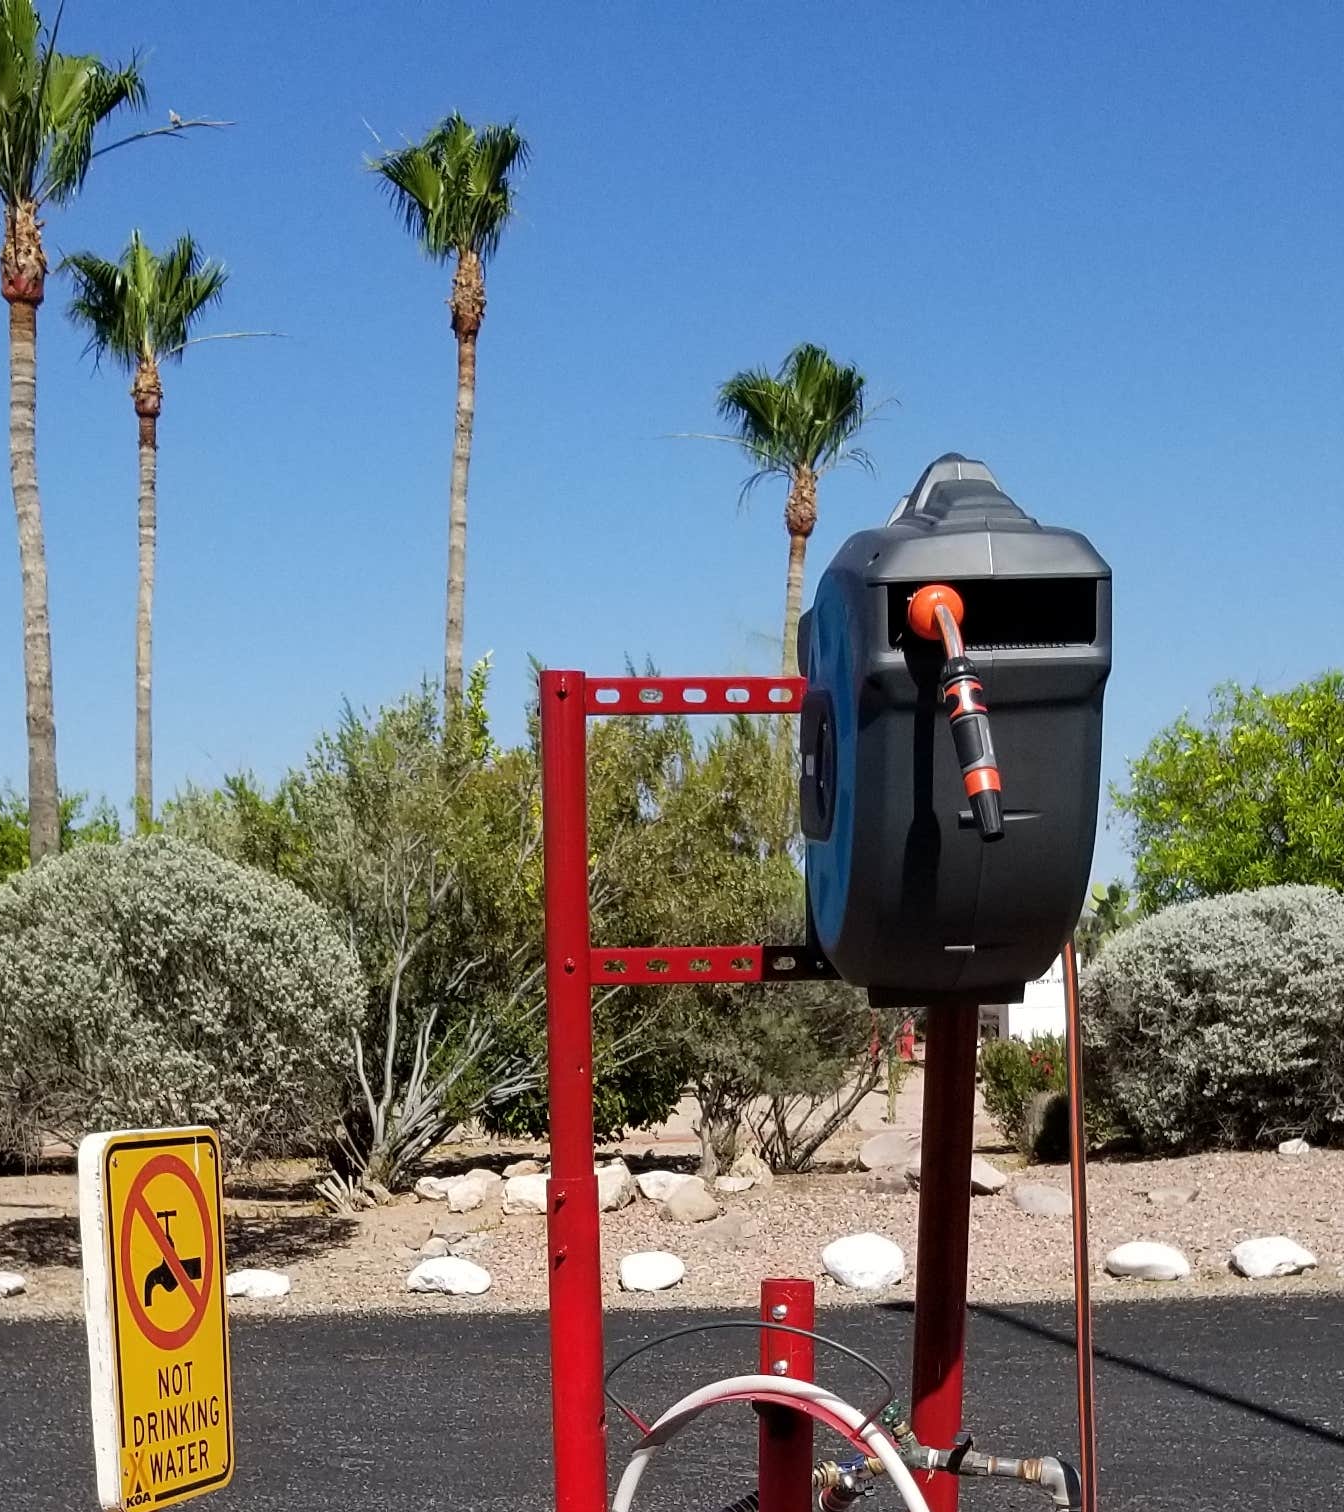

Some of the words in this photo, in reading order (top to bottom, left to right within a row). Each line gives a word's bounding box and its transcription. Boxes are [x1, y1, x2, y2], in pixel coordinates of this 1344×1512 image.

[158, 1361, 193, 1400] NOT
[133, 1395, 219, 1447] DRINKING
[150, 1439, 209, 1485] WATER
[126, 1492, 151, 1508] KOA
